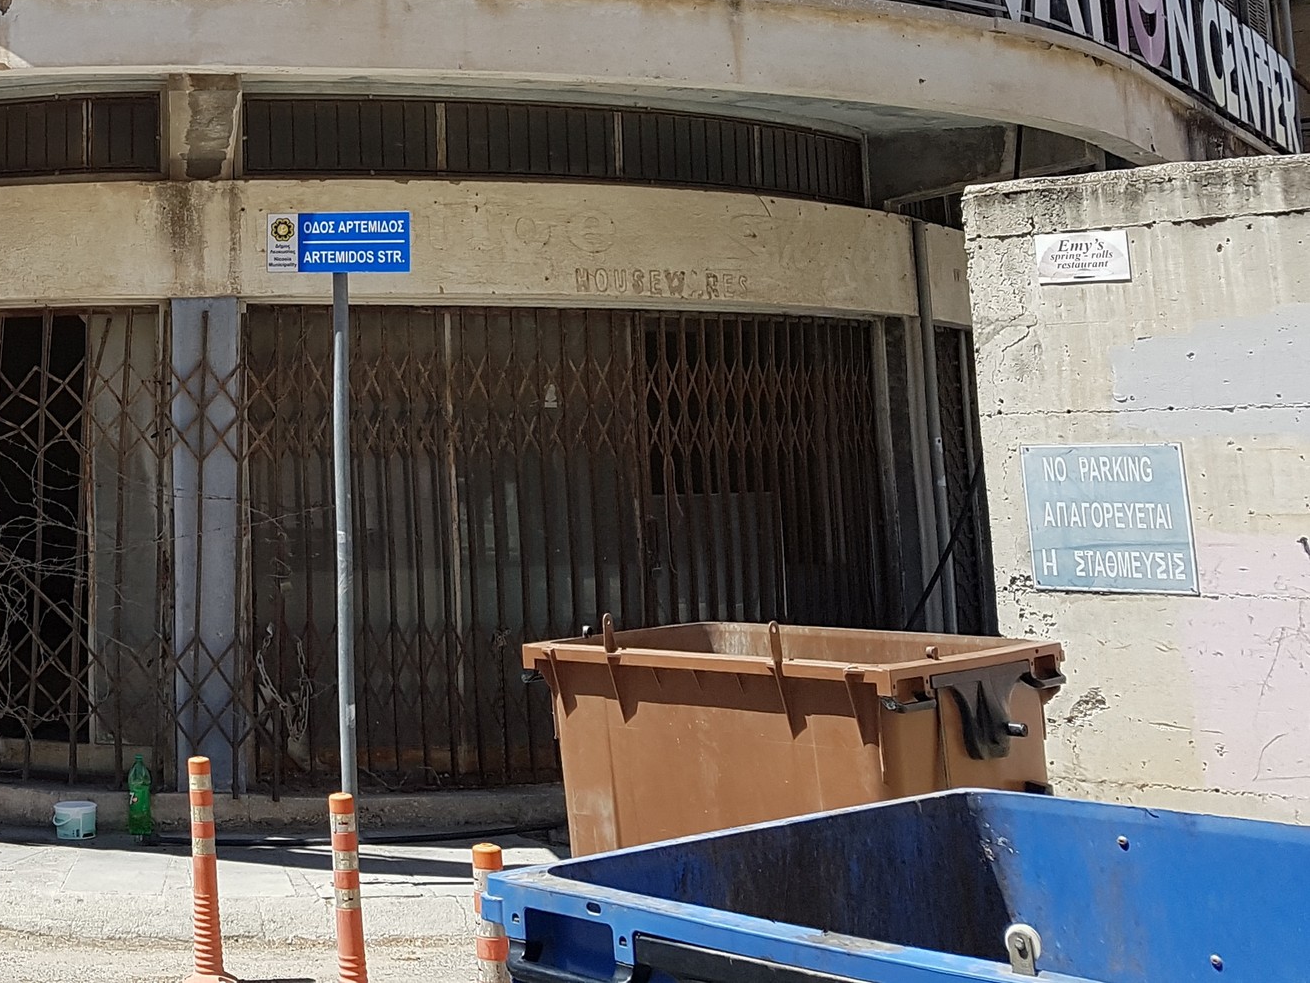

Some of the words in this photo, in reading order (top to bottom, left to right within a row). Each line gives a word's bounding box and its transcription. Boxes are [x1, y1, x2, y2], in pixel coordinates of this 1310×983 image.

[303, 221, 335, 234] ΟΔΟΣ
[338, 220, 405, 234] ΑΡΤΕΜΙΔΟΣ
[1058, 238, 1105, 254] Emy's
[303, 251, 374, 263] ARTEMIDOS
[377, 250, 405, 263] STR.
[1049, 251, 1081, 262] spring
[1091, 250, 1114, 260] rolls
[1057, 260, 1109, 270] restaurant
[575, 267, 748, 301] HOUSEWRES
[1043, 456, 1067, 482] NO
[1079, 456, 1153, 483] PARKING
[1044, 501, 1173, 529] ΑΠΑΓΟΡΕΥΕΤΑΙ
[1042, 549, 1058, 576] Η
[1074, 550, 1187, 580] ΣΤΑΘΜΕΥΣΙΣ
